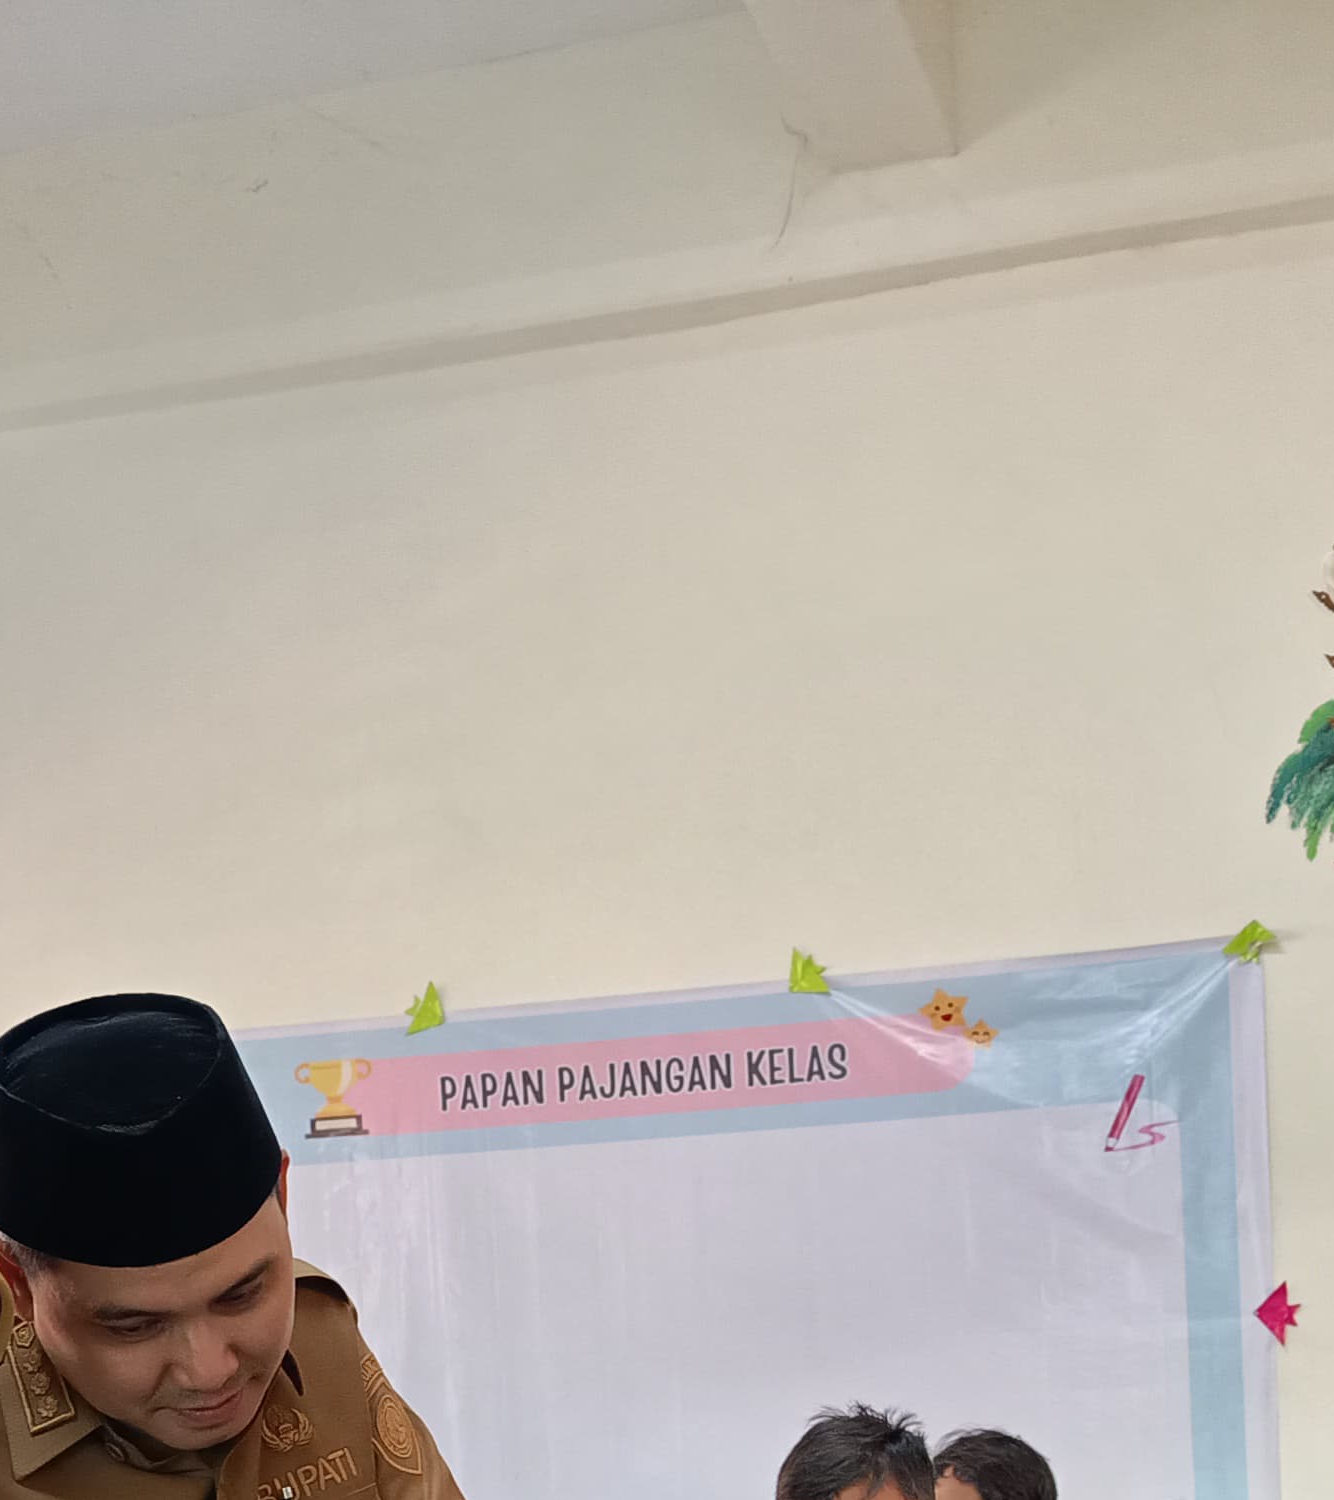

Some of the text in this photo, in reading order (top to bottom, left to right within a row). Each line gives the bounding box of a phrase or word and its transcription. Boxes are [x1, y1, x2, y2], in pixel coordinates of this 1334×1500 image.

[439, 1042, 848, 1112] PAPAN PAJANGAN KELAS
